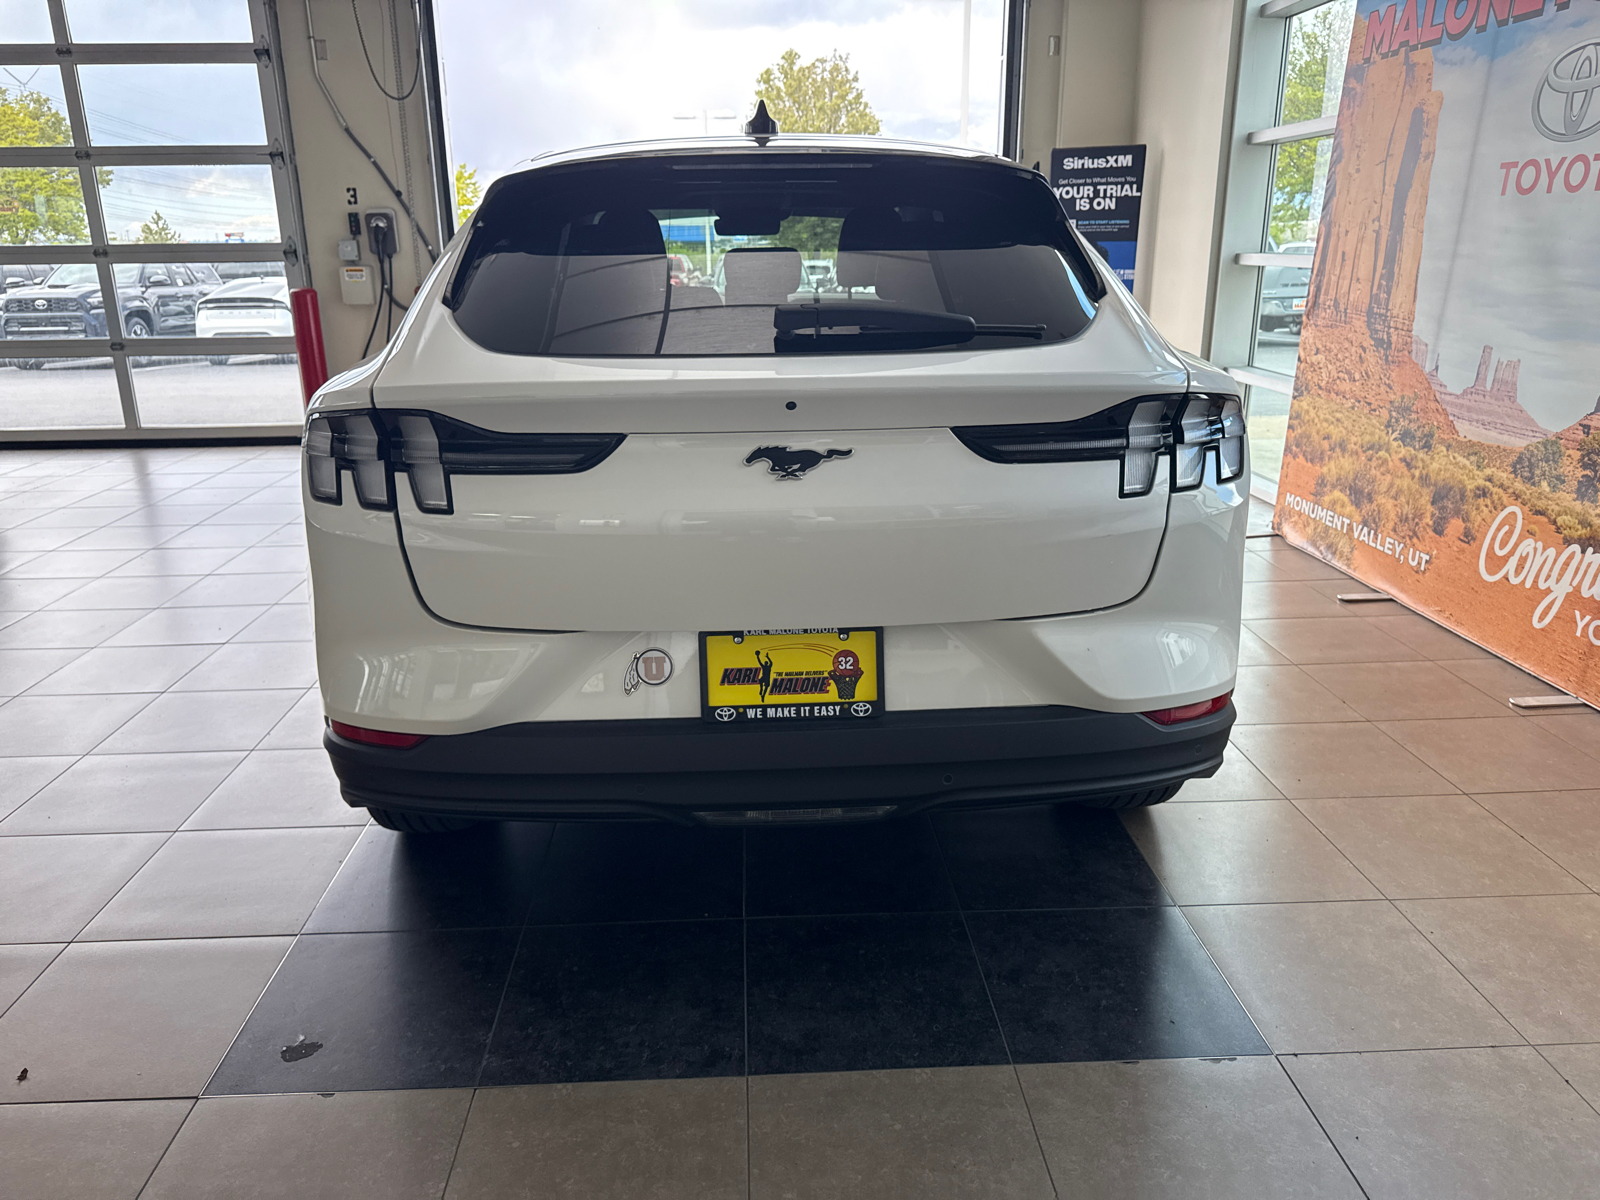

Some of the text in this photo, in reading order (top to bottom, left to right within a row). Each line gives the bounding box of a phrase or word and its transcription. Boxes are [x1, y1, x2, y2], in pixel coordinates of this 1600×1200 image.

[1362, 0, 1545, 63] MALON
[1063, 154, 1133, 170] SiriusXM
[346, 187, 358, 205] 3
[1053, 184, 1141, 199] YOUR TRIAL
[1075, 198, 1116, 211] IS ON
[1285, 491, 1430, 571] MONUMENT VALLEY, UT
[1479, 505, 1600, 629] Congr
[838, 656, 854, 670] 32
[719, 667, 762, 686] KARL
[768, 676, 832, 695] MALONE
[746, 705, 841, 719] WE MAKE IT EASY
